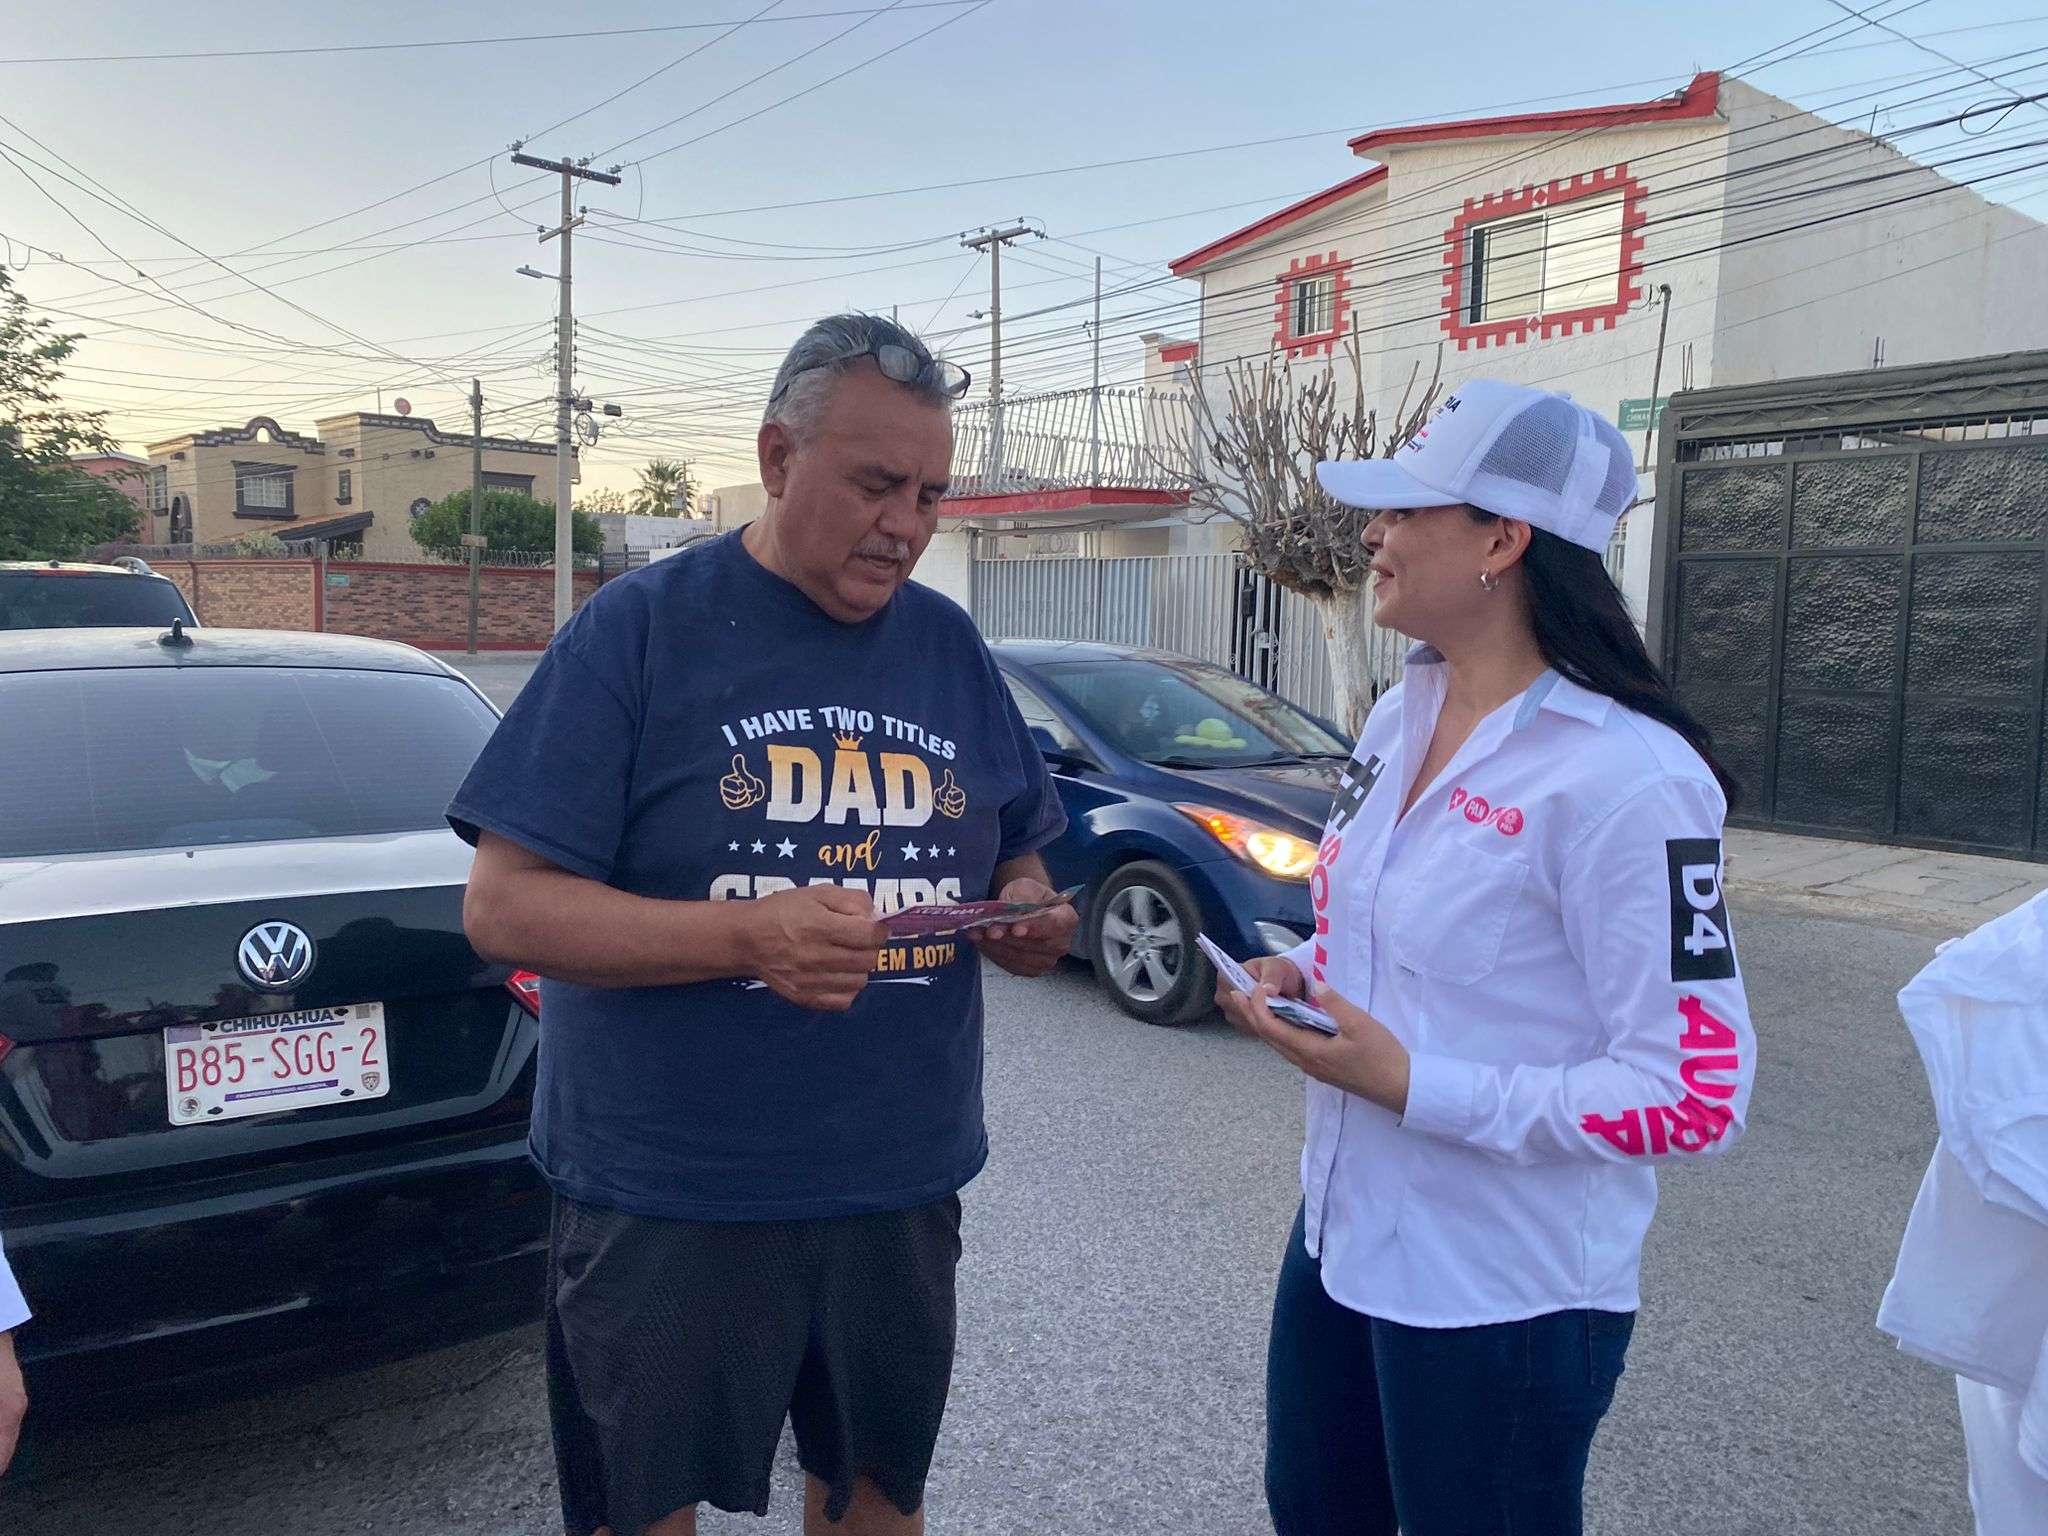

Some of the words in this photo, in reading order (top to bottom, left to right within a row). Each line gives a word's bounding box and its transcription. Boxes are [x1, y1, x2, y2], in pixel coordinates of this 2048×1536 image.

[721, 724, 738, 747] I
[740, 708, 814, 740] HAVE
[818, 706, 875, 731] TWO
[881, 714, 957, 761] TITLES
[766, 744, 934, 827] DAD
[818, 829, 882, 871] and
[1681, 862, 1727, 956] D4
[871, 947, 906, 973] EM
[913, 943, 956, 969] BOTH
[219, 1008, 335, 1034] CHIHUAHUA
[176, 1027, 379, 1093] B85-SGG-2
